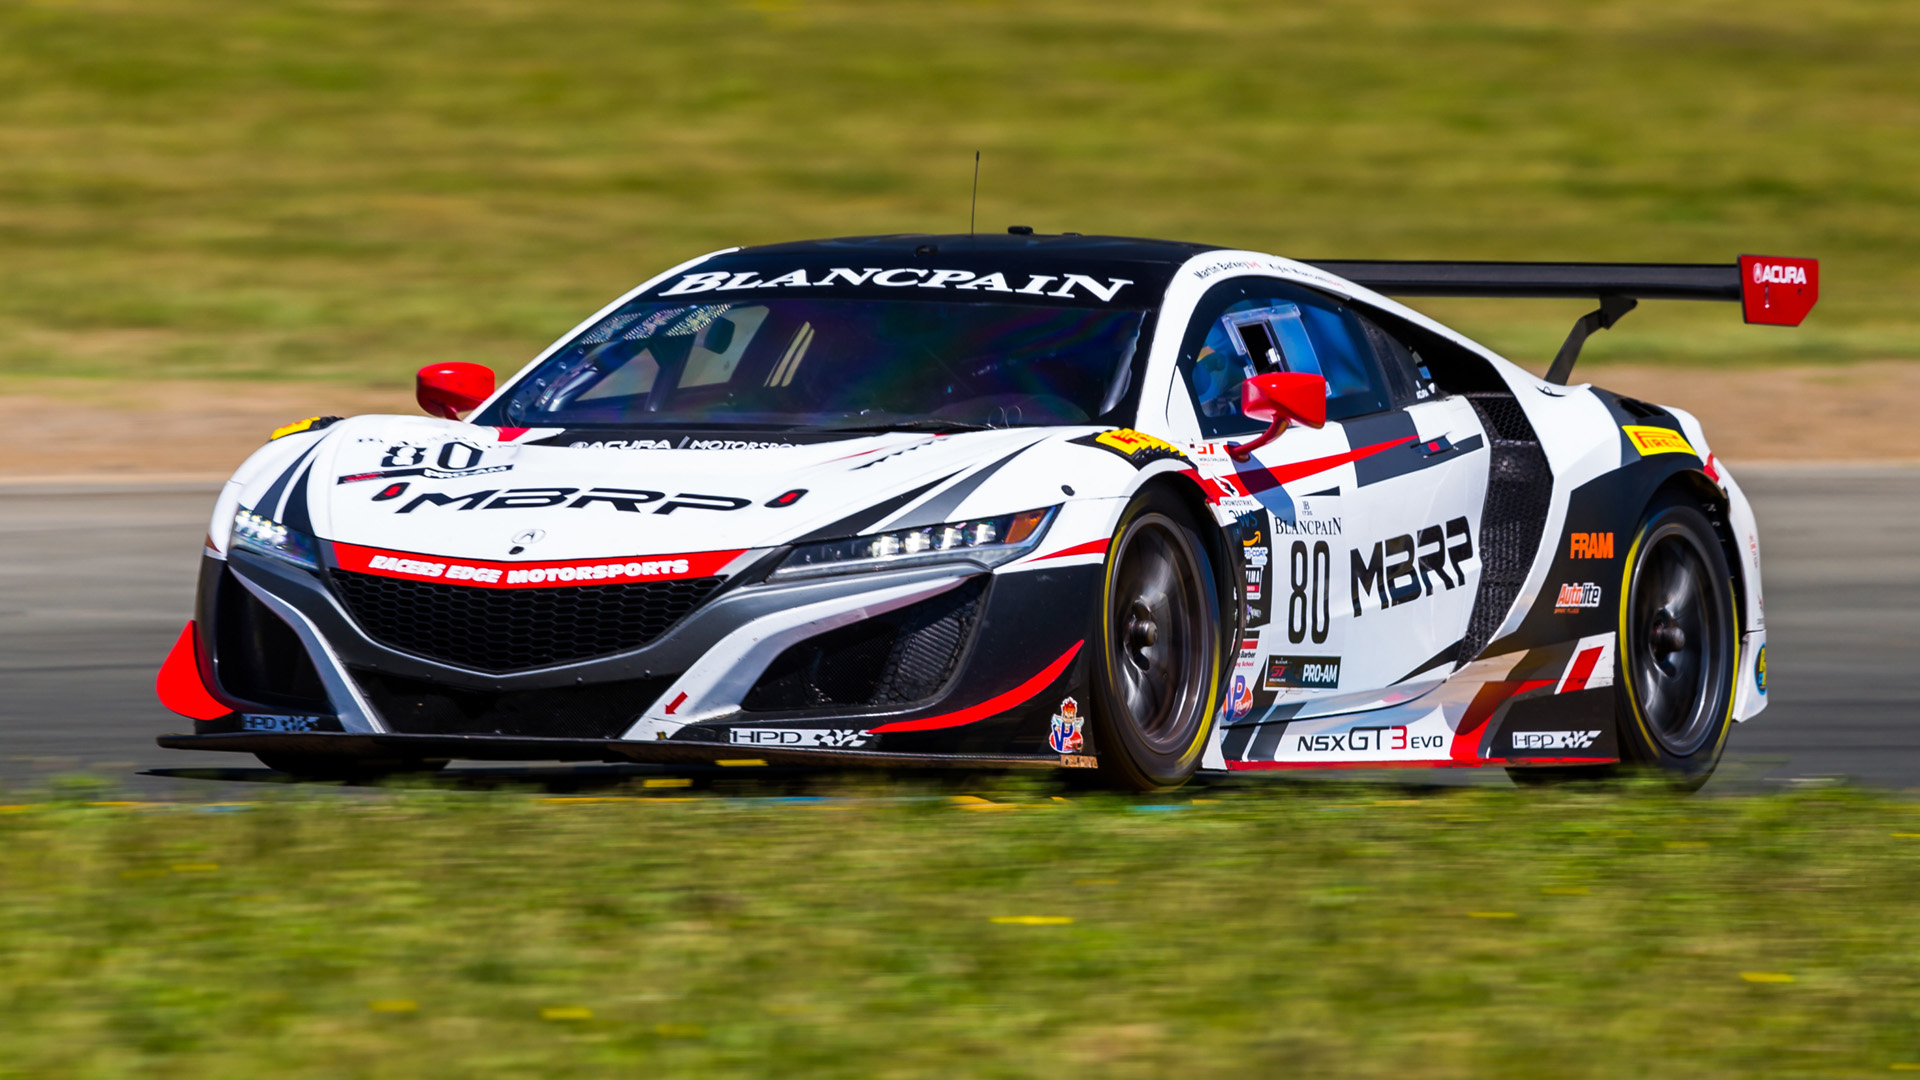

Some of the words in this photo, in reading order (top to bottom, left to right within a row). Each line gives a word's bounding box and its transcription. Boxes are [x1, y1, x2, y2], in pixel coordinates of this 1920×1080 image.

[658, 267, 1134, 302] BLANCPAIN
[1762, 264, 1807, 284] ACURA
[394, 487, 753, 515] MBRP
[1274, 516, 1342, 535] BLANCPAIN
[1570, 532, 1614, 559] FRAM
[368, 555, 446, 577] RACERS
[445, 565, 503, 583] EDGE
[506, 559, 689, 584] MOTORSPORTS
[1350, 515, 1473, 617] MBRP
[1288, 540, 1330, 644] 80
[1556, 583, 1601, 606] Autolite
[1302, 664, 1338, 682] PRO-AM
[732, 730, 803, 744] HPD
[1411, 735, 1443, 749] EVO
[1514, 732, 1554, 748] HPD
